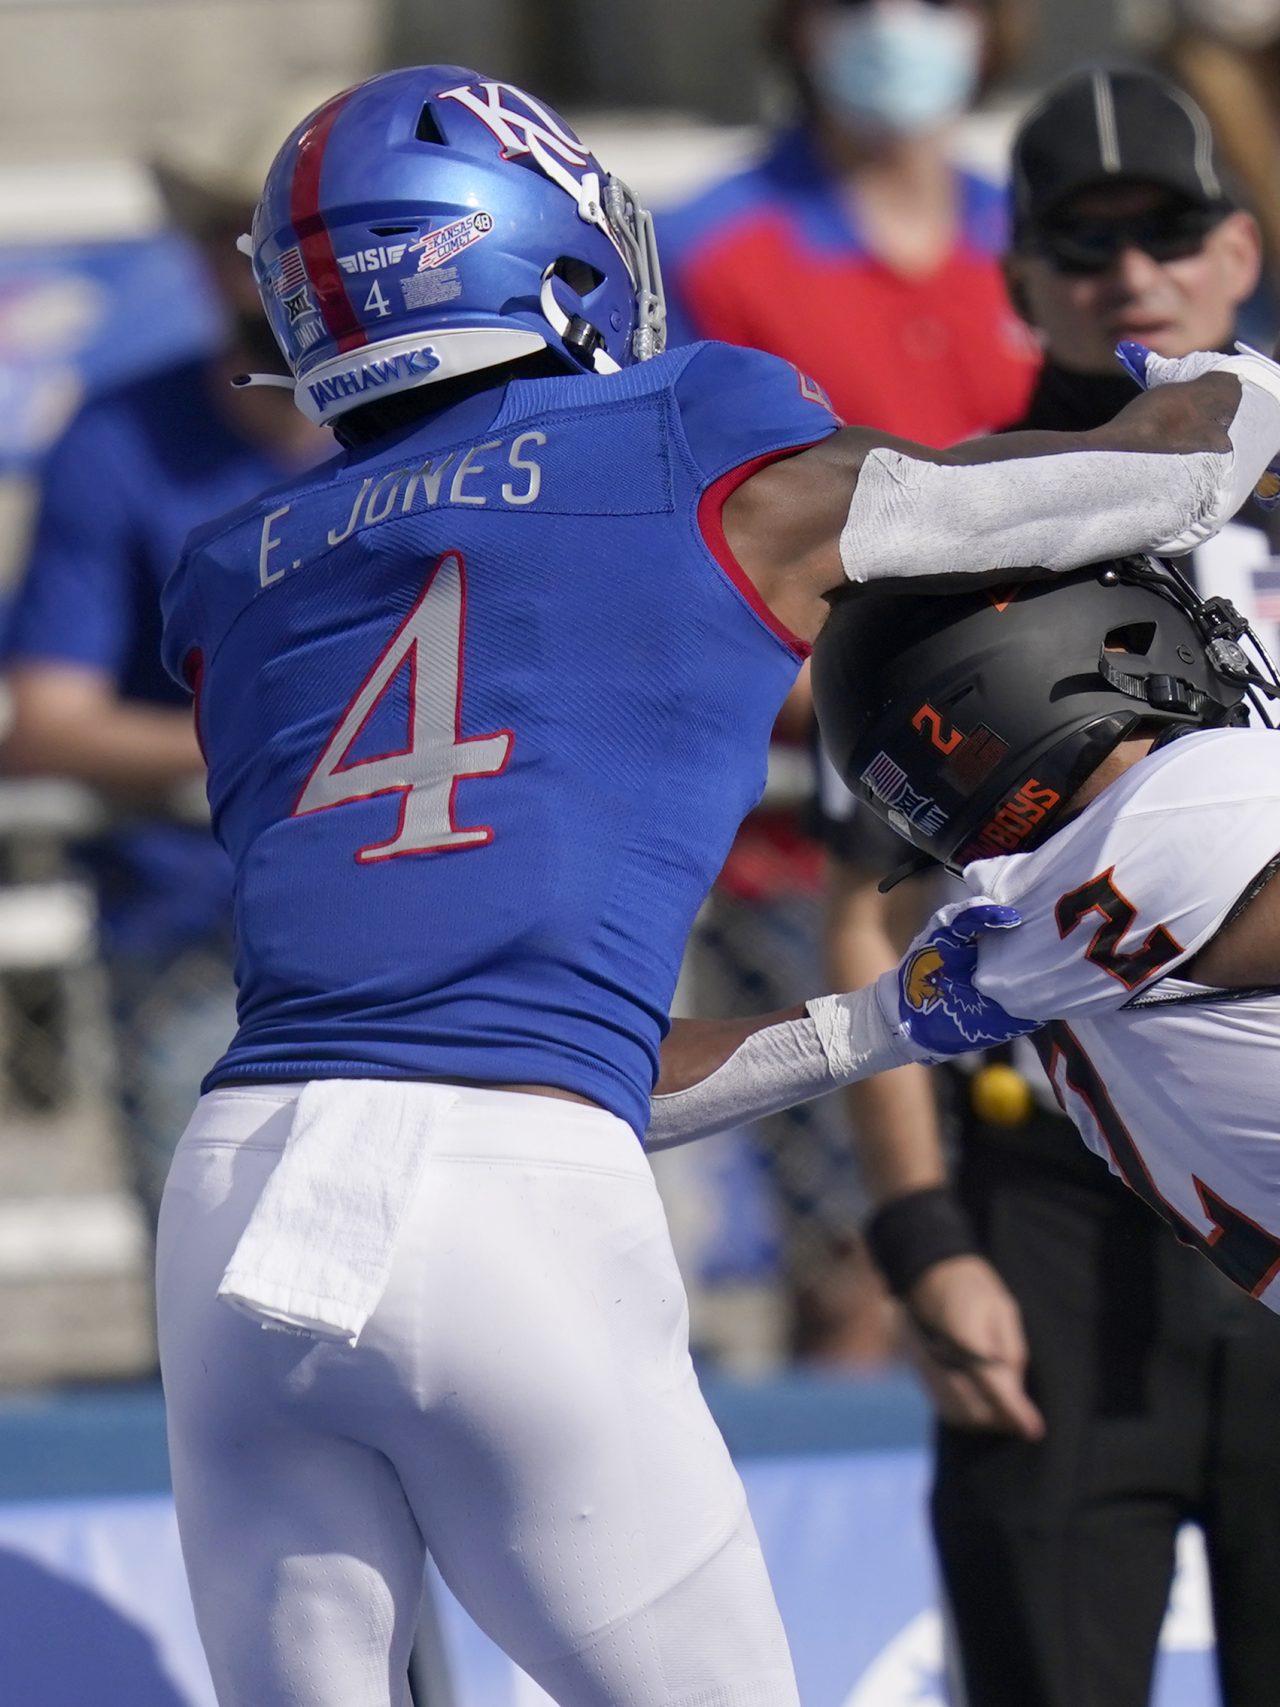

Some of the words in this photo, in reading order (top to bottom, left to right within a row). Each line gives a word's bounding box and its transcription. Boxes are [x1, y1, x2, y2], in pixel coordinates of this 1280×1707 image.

[432, 217, 474, 248] KANSAS
[437, 231, 471, 258] COMET
[473, 214, 491, 230] 48
[364, 279, 392, 318] 4
[294, 316, 327, 349] UNITY
[307, 347, 441, 412] JAYHAWKS
[258, 507, 300, 588] E.
[327, 431, 547, 547] JONES
[291, 549, 515, 865] 4
[911, 703, 964, 755] 2
[1053, 865, 1186, 991] 2
